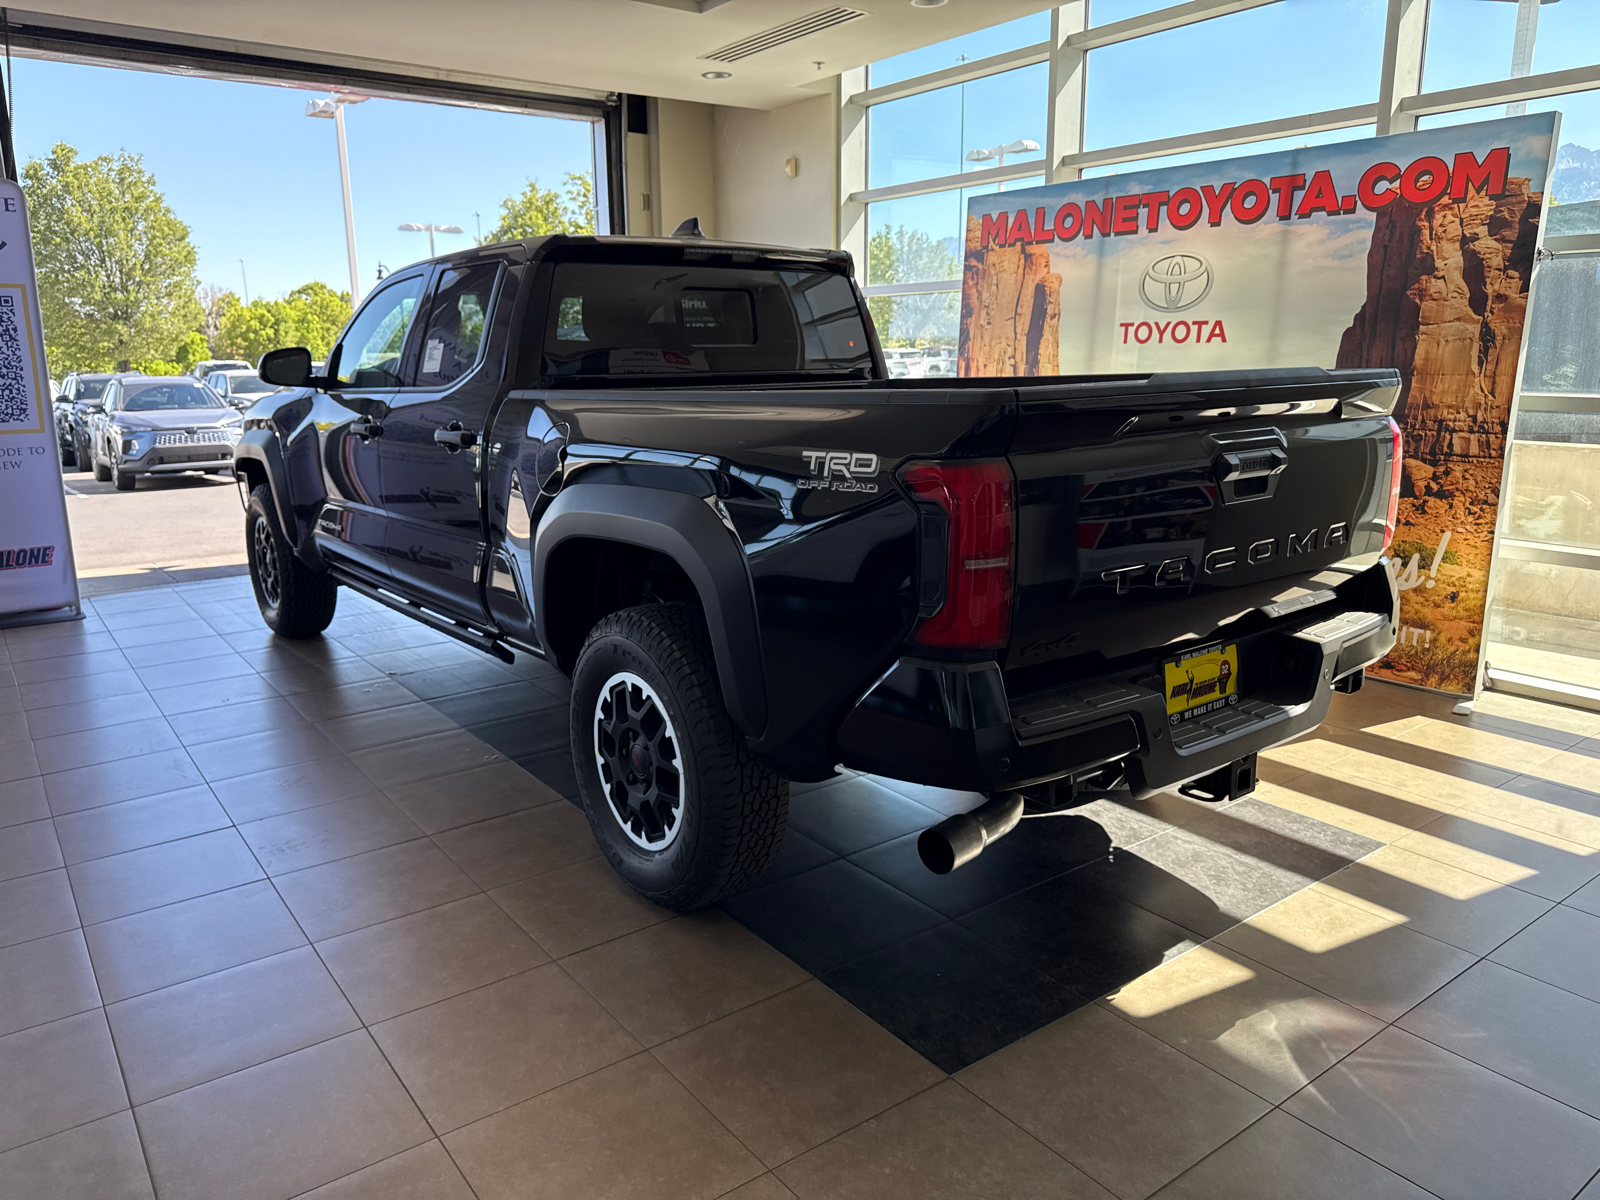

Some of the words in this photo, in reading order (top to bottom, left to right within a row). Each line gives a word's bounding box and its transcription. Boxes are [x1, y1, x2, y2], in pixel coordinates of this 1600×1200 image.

[0, 196, 17, 213] E
[979, 146, 1512, 249] MALONETOYOTA.COM
[1119, 320, 1227, 344] TOYOTA
[27, 446, 46, 456] TO
[0, 460, 22, 470] EW
[802, 451, 880, 483] TRD
[796, 478, 829, 490] OFF
[831, 481, 879, 493] ROAD
[1101, 521, 1350, 595] TACOMA
[1400, 626, 1431, 649] IT!
[1180, 652, 1192, 661] KARL
[1192, 648, 1208, 658] MALONE
[1221, 664, 1229, 675] 32
[1184, 710, 1192, 719] WE
[1193, 705, 1207, 717] MAKE
[1207, 702, 1213, 712] IT
[1213, 698, 1226, 710] EASY
